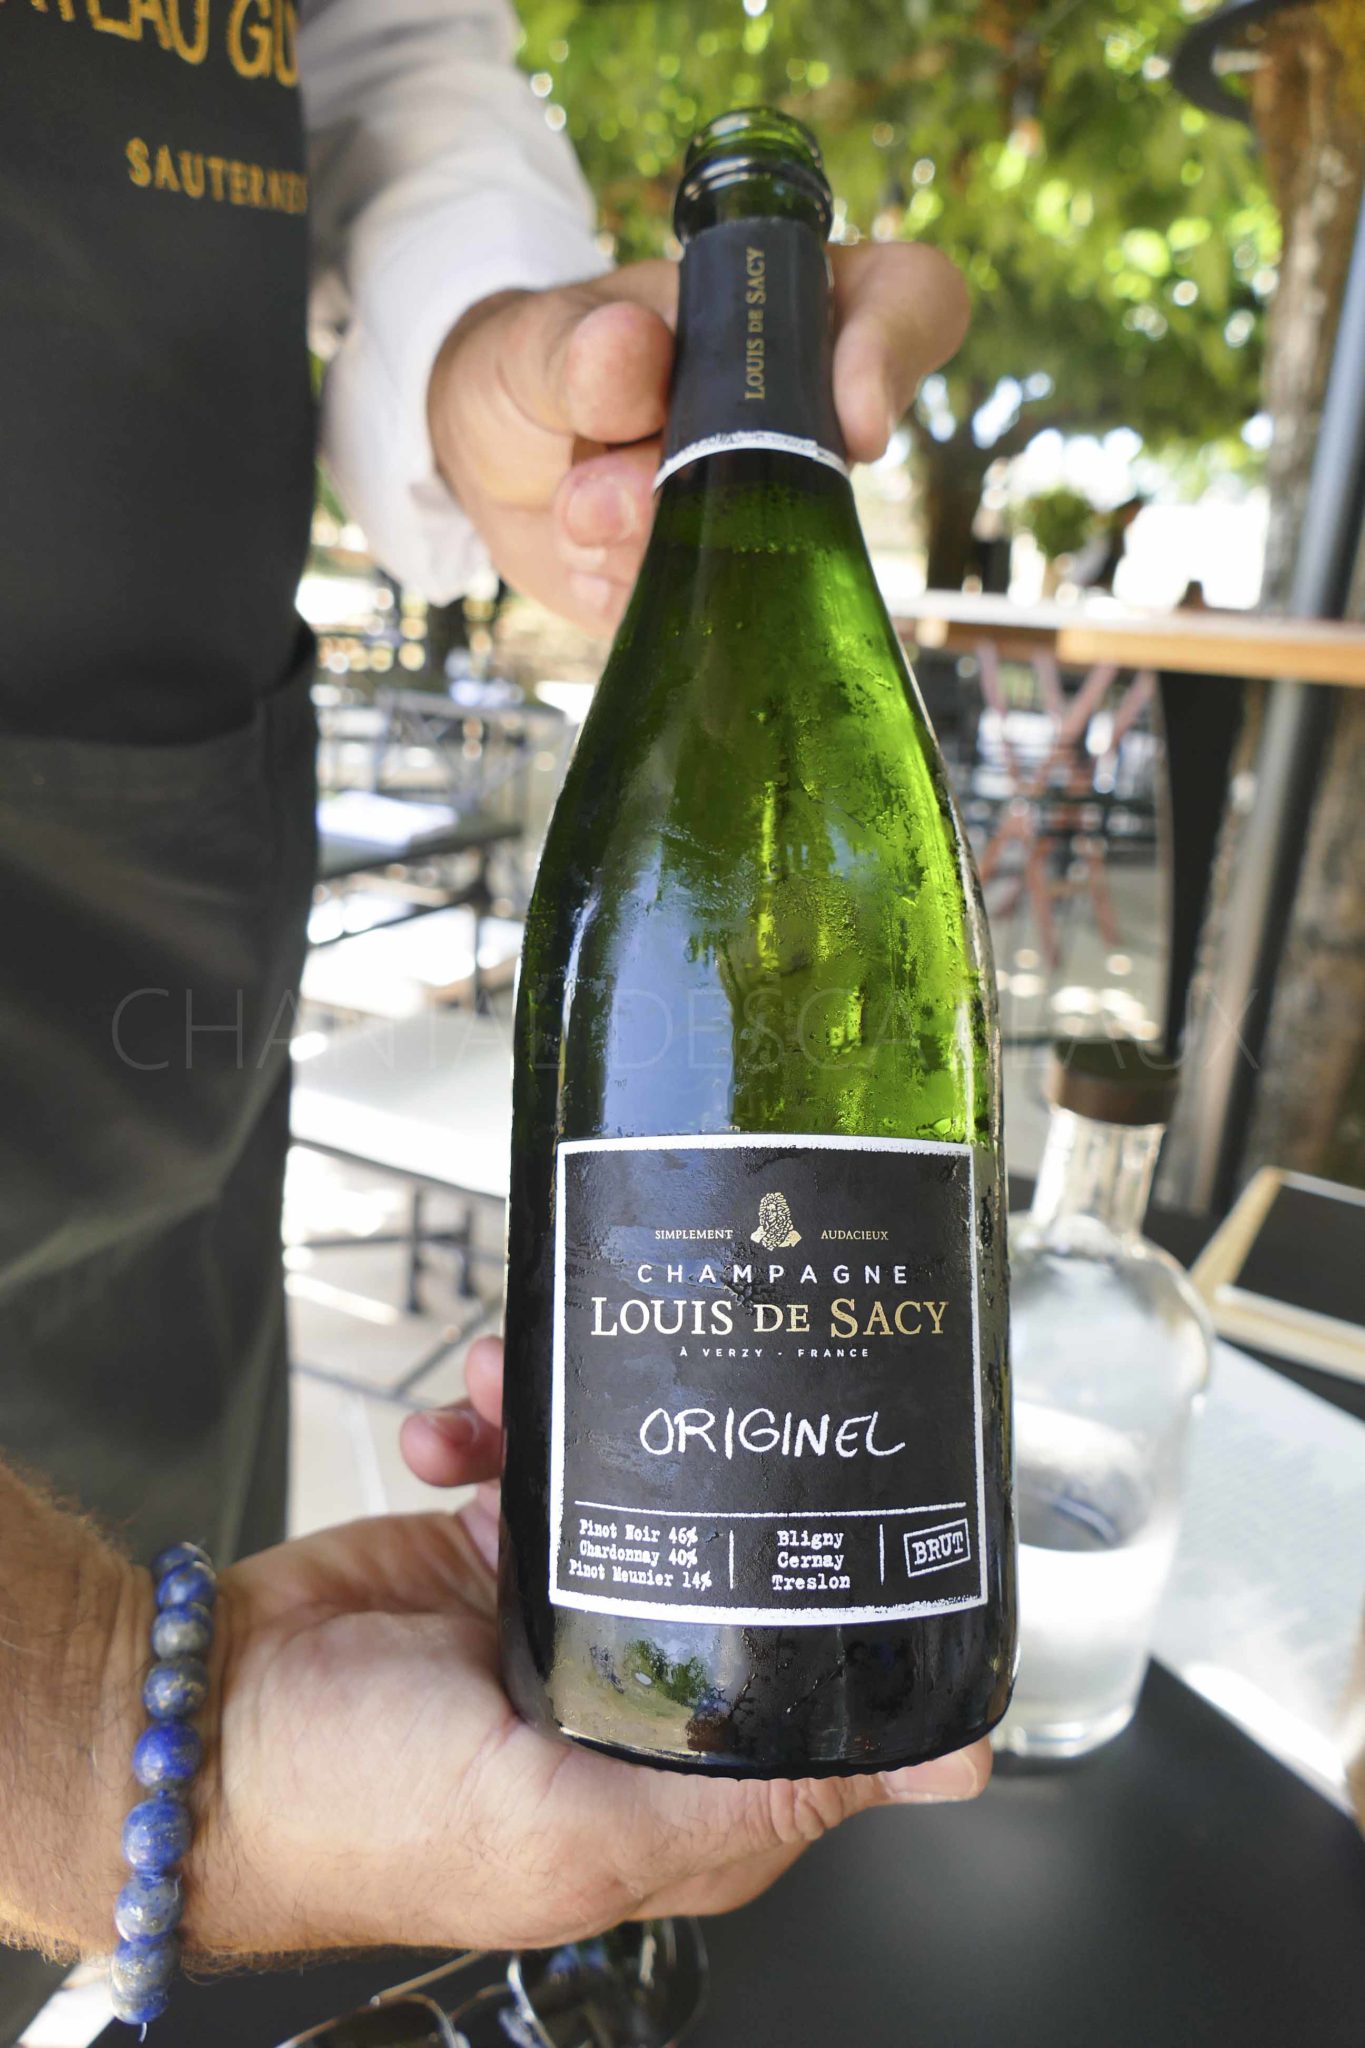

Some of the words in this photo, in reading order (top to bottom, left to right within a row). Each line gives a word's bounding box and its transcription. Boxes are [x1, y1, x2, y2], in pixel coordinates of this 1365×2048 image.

[745, 247, 767, 305] SACY
[747, 309, 764, 333] DE
[745, 337, 766, 400] LOUIS
[655, 1229, 734, 1241] SIMPLEMENT
[820, 1229, 890, 1241] AUDACIEUX
[636, 1263, 908, 1285] CHAMPAGNE
[590, 1297, 734, 1337] LOUIS
[753, 1303, 811, 1334] DE
[829, 1297, 950, 1340] SACY
[702, 1348, 763, 1358] VERZY
[797, 1348, 870, 1358] FRANCE
[639, 1407, 906, 1460] ORIGINEL
[579, 1518, 618, 1539] Pinot
[624, 1524, 661, 1543] Noir
[668, 1526, 699, 1547] 46%
[776, 1529, 844, 1550] Bligny
[579, 1539, 660, 1567] Chardonnay
[668, 1548, 698, 1568] 40%
[776, 1551, 845, 1571] Cernay
[911, 1530, 964, 1566] BRUT
[568, 1558, 606, 1581] Pinot
[612, 1565, 674, 1587] Meunier
[682, 1570, 713, 1592] 14%
[771, 1573, 851, 1591] Treslon
